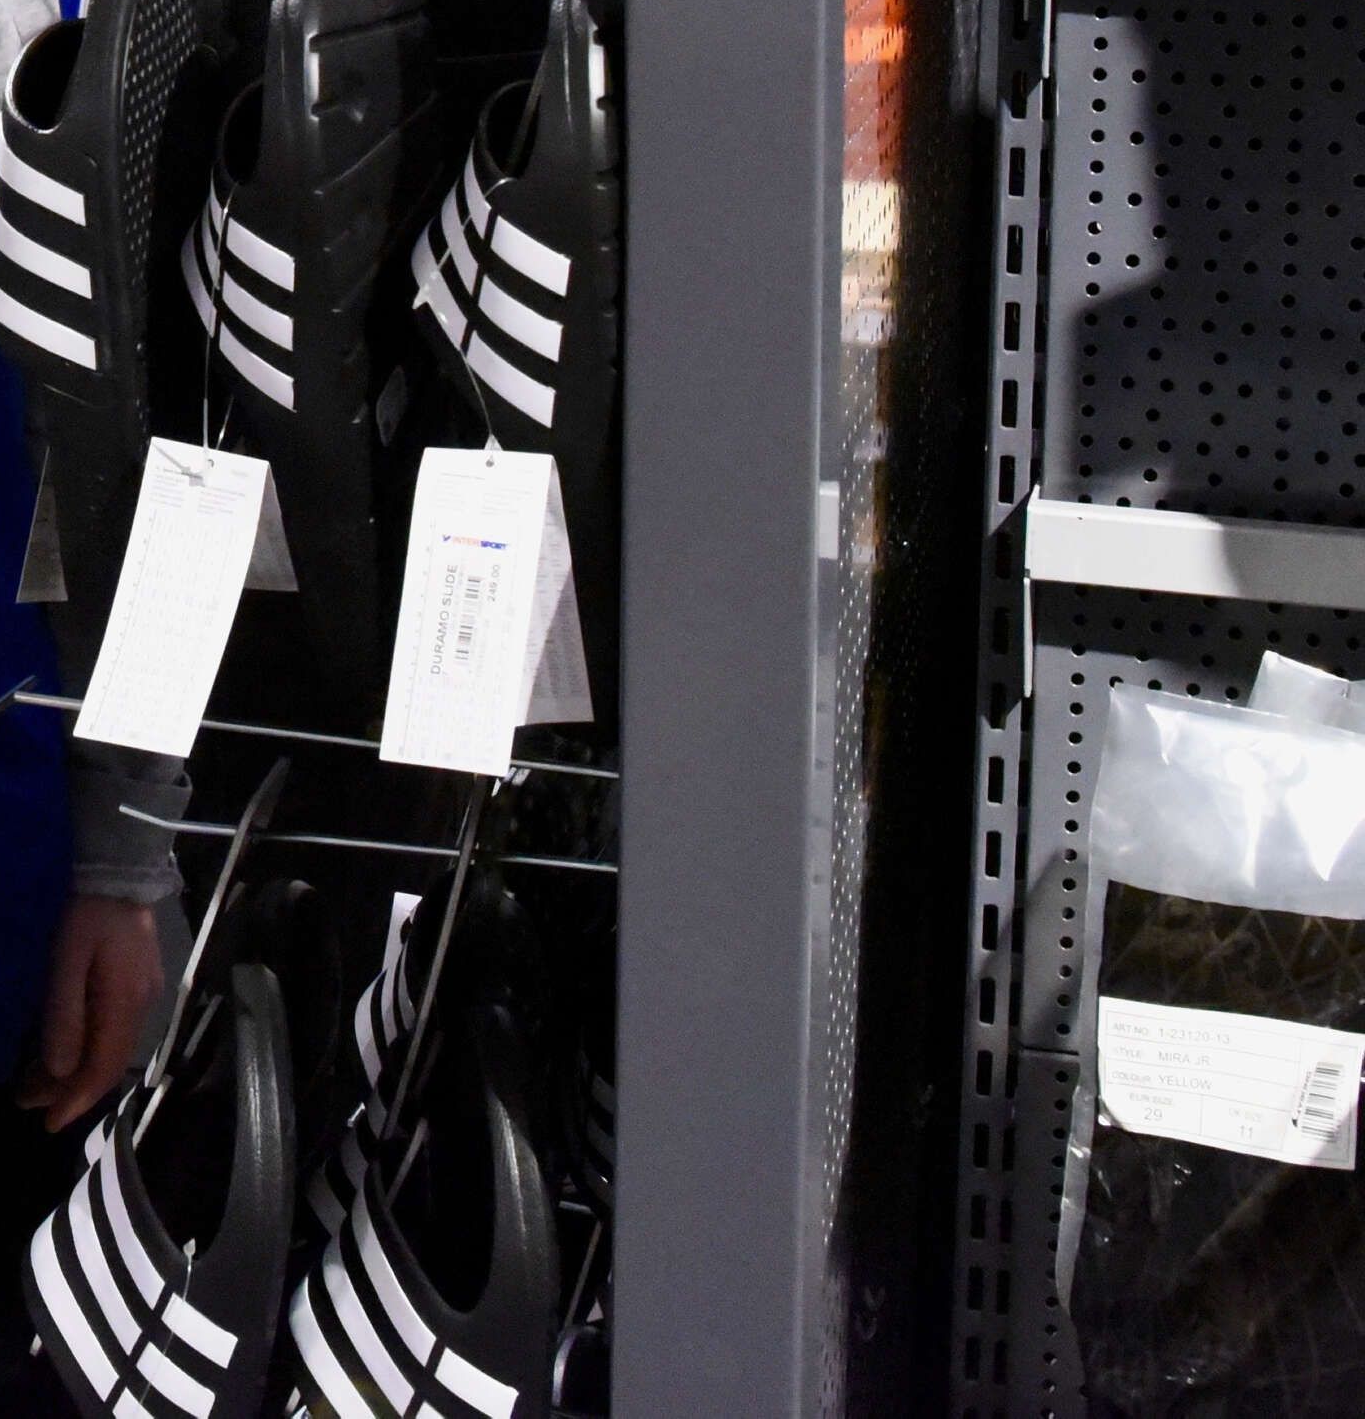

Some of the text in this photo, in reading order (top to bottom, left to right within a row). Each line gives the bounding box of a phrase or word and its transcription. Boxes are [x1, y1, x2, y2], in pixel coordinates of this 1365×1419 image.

[430, 564, 458, 675] DURAMO SLIDE
[1158, 1050, 1191, 1064] MIRA
[1157, 1074, 1213, 1091] YELLOW
[1143, 1107, 1164, 1121] 29
[1238, 1124, 1254, 1141] 11
